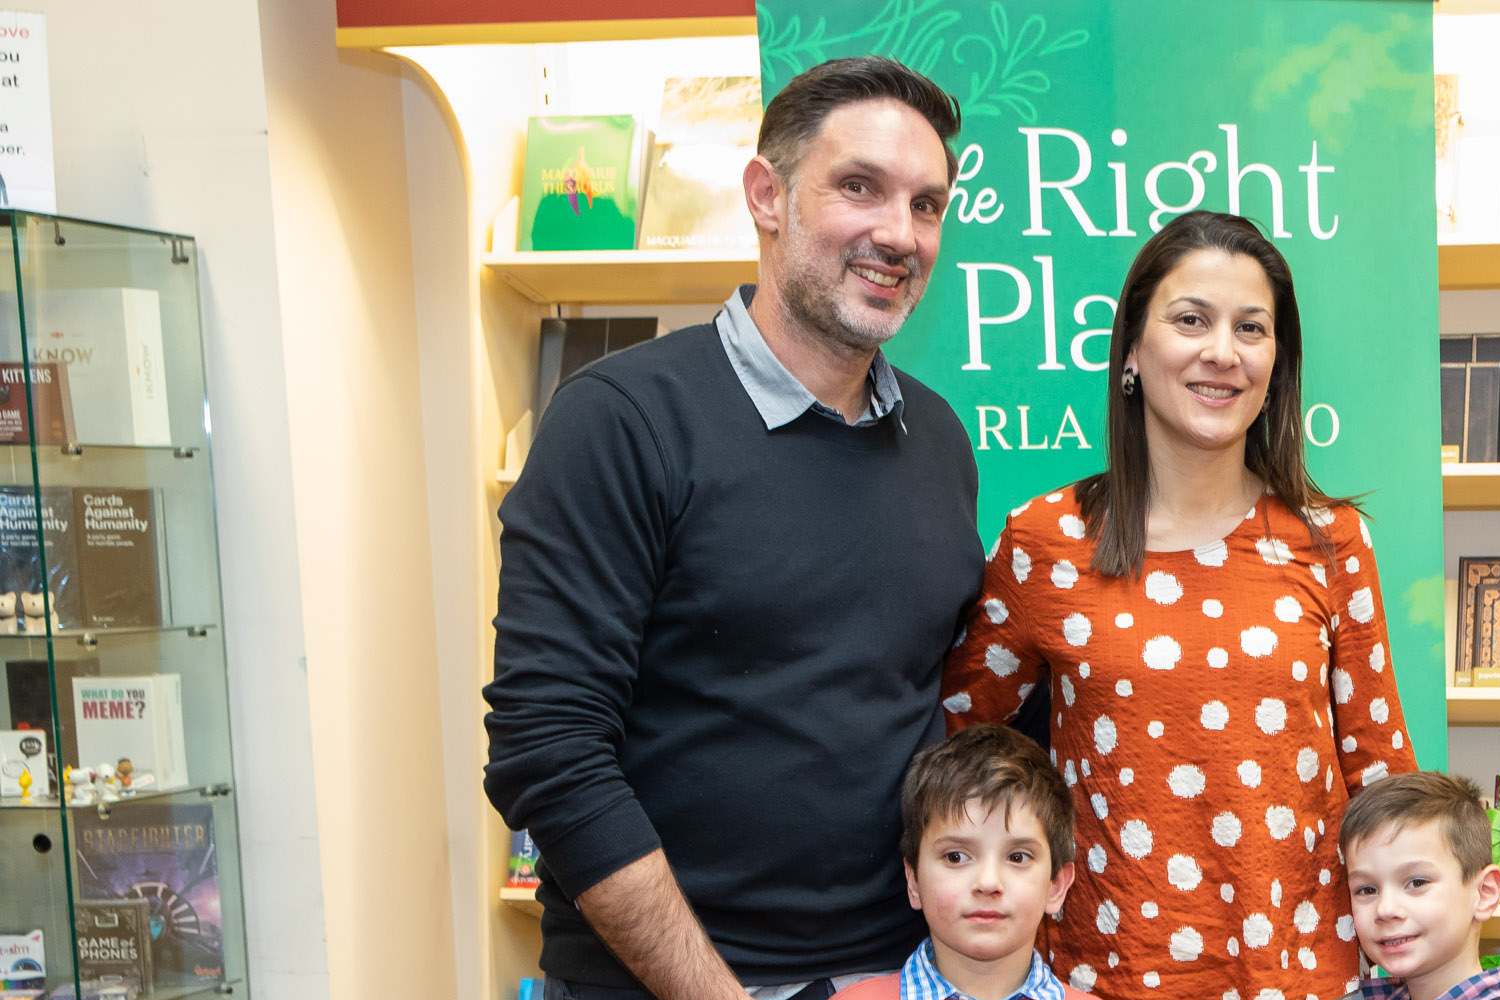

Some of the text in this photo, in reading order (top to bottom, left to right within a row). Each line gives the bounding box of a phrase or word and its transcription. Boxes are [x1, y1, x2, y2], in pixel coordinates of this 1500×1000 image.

[942, 123, 1339, 240] he Right
[957, 255, 1118, 372] Pla
[976, 404, 1092, 451] RLA
[0, 494, 35, 506] Card
[83, 494, 123, 506] Cards
[84, 506, 134, 520] Against
[85, 518, 148, 533] Humanity
[81, 689, 145, 699] WHAT DO YOU
[82, 701, 146, 720] MEME?
[78, 937, 117, 948] GAME
[80, 949, 138, 960] PHONES
